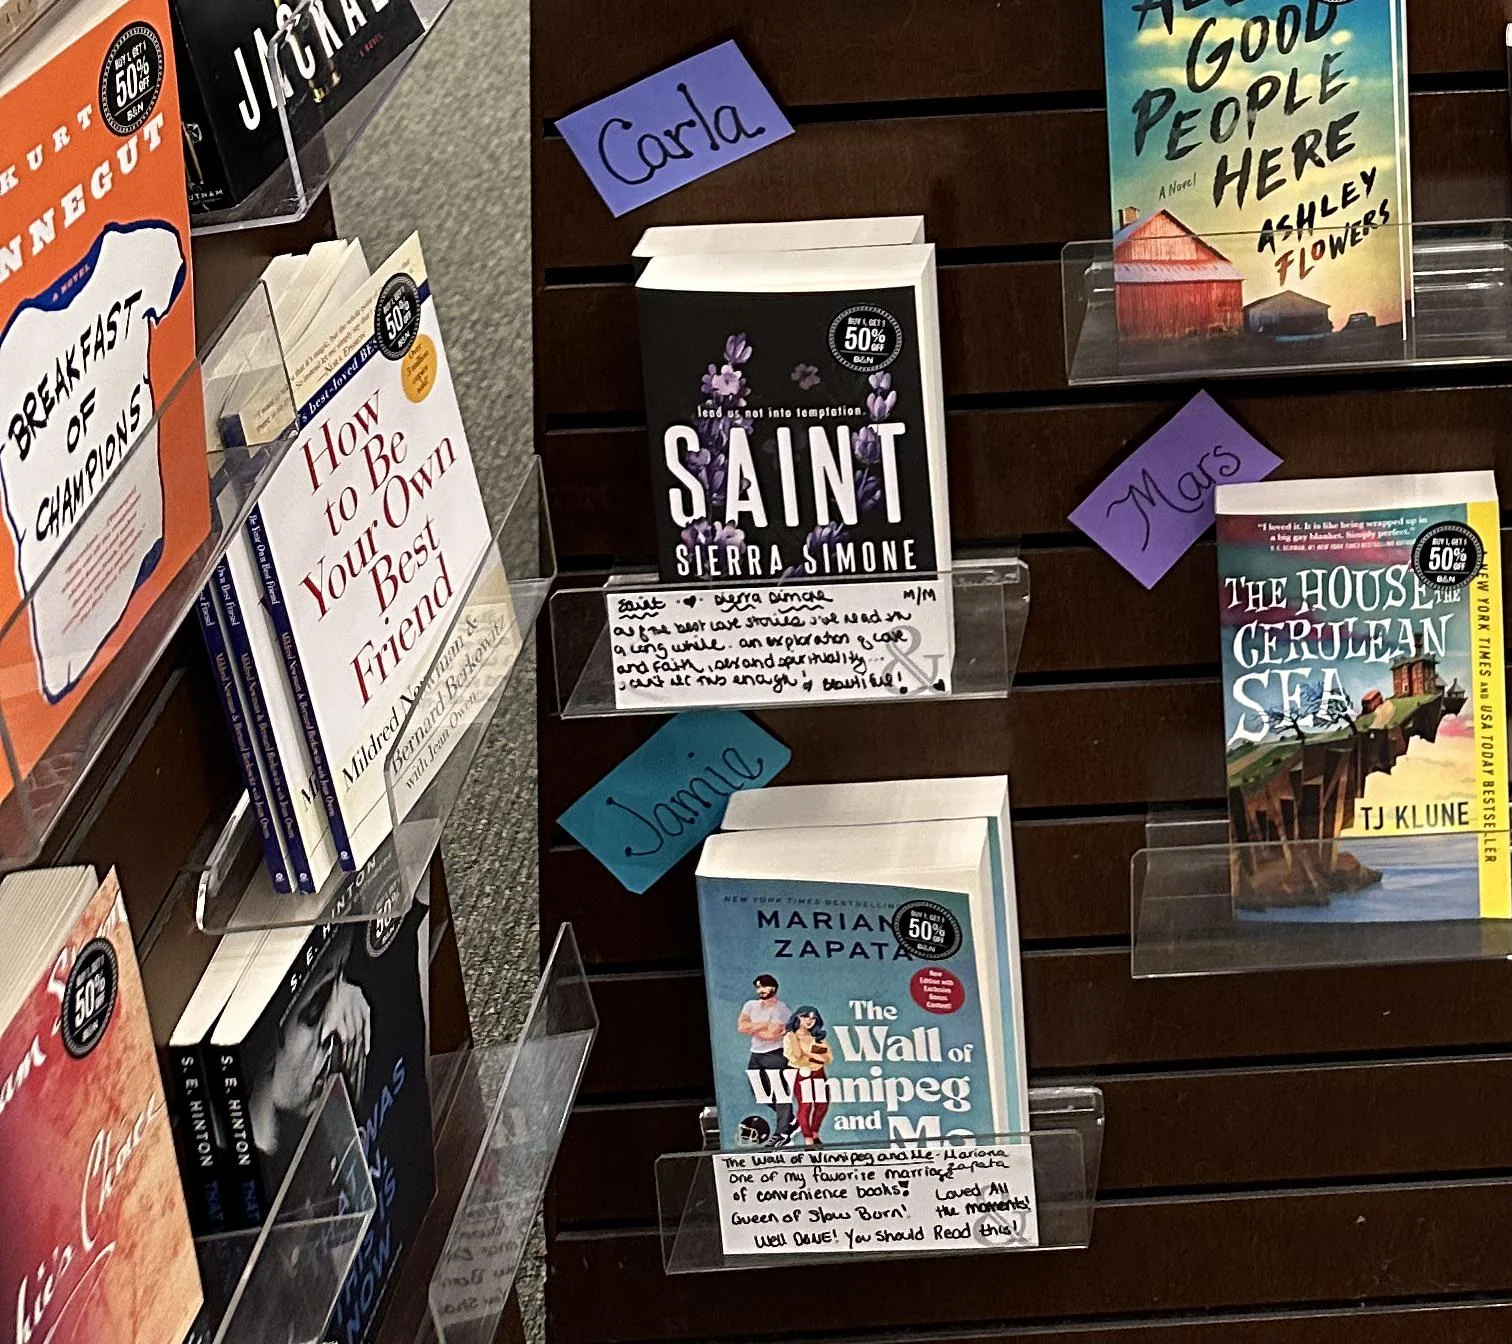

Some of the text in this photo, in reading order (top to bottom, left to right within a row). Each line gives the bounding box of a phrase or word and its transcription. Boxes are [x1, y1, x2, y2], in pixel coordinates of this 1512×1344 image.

[0, 102, 94, 198] KURT
[597, 81, 767, 186] Carla
[1130, 50, 1351, 162] PEOPLE
[1212, 110, 1361, 212] HERE
[1256, 166, 1378, 255] ASHLEY
[1273, 198, 1391, 289] FLOWERS
[6, 288, 144, 463] BREAKFAST
[34, 383, 143, 542] CHAMPIONS
[64, 388, 97, 455] OF
[300, 389, 384, 495] How
[323, 425, 410, 540] to Be
[663, 421, 907, 529] SAINT
[1106, 443, 1243, 552] Mars
[296, 436, 457, 623] Your Own
[368, 517, 443, 617] Best
[675, 538, 918, 577] SIERRA SIMONE
[348, 554, 456, 708] Friend
[1225, 564, 1434, 616] THE HOUSE
[1434, 588, 1462, 604] THE
[1231, 612, 1456, 670] CERULEAN
[1228, 666, 1352, 745] SEA
[605, 746, 765, 858] Jamie
[1359, 801, 1471, 832] TJ KLUNE
[756, 910, 898, 932] MARIAN
[773, 939, 915, 962] ZAPATA
[832, 1024, 975, 1064] Wall of
[848, 999, 899, 1021] The
[228, 1098, 254, 1166] HINTON
[744, 1065, 972, 1113] Winnipeg
[832, 1111, 882, 1131] and
